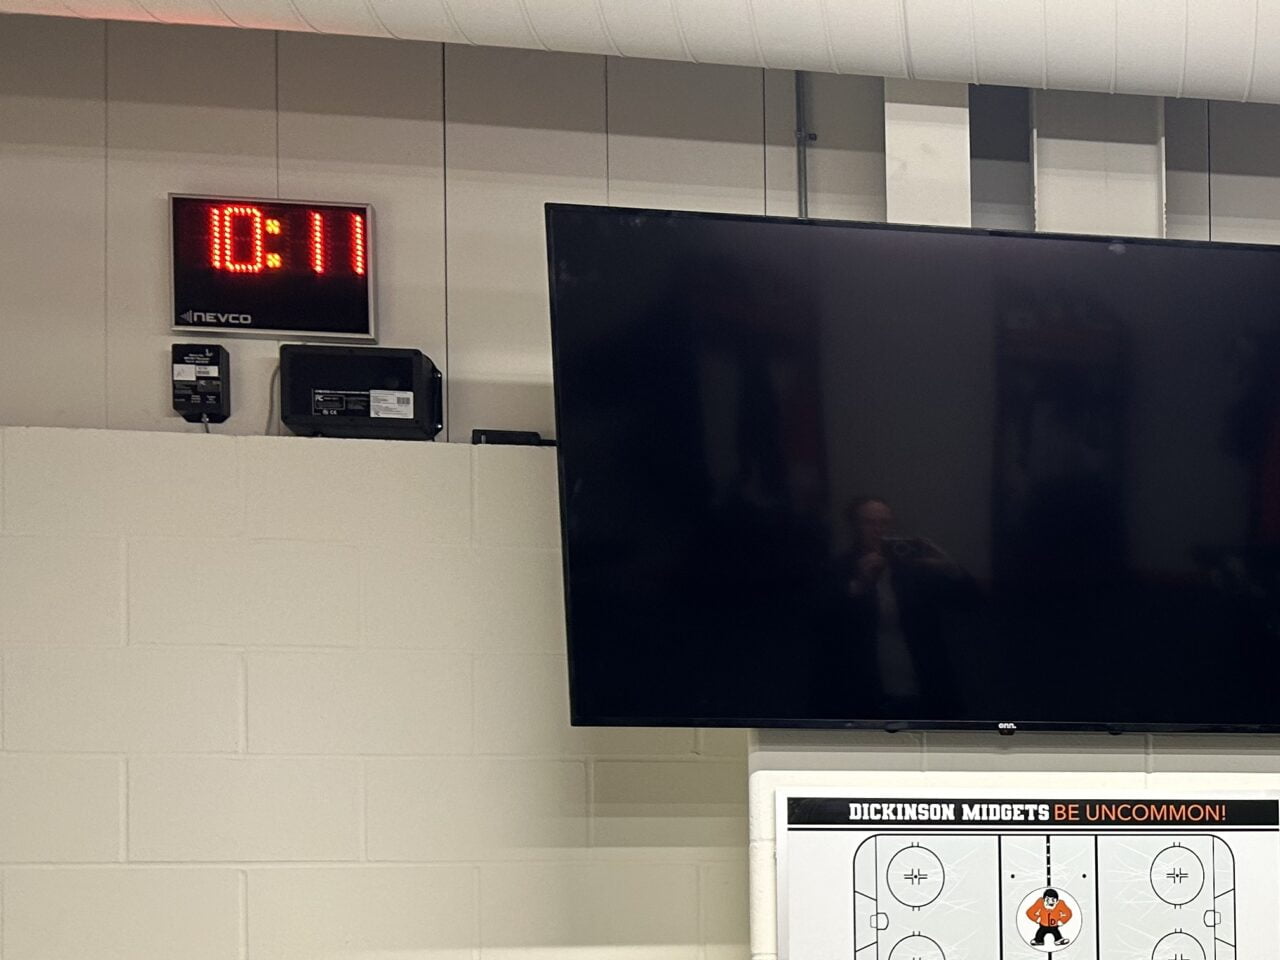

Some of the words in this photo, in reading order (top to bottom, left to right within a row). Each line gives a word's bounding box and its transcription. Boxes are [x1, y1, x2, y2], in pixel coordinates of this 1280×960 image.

[209, 206, 366, 275] 10:11
[849, 803, 955, 821] DICKINSON
[962, 804, 1050, 821] MIDGETS
[1054, 804, 1080, 821] BE
[1086, 804, 1227, 821] UNCOMMON!
